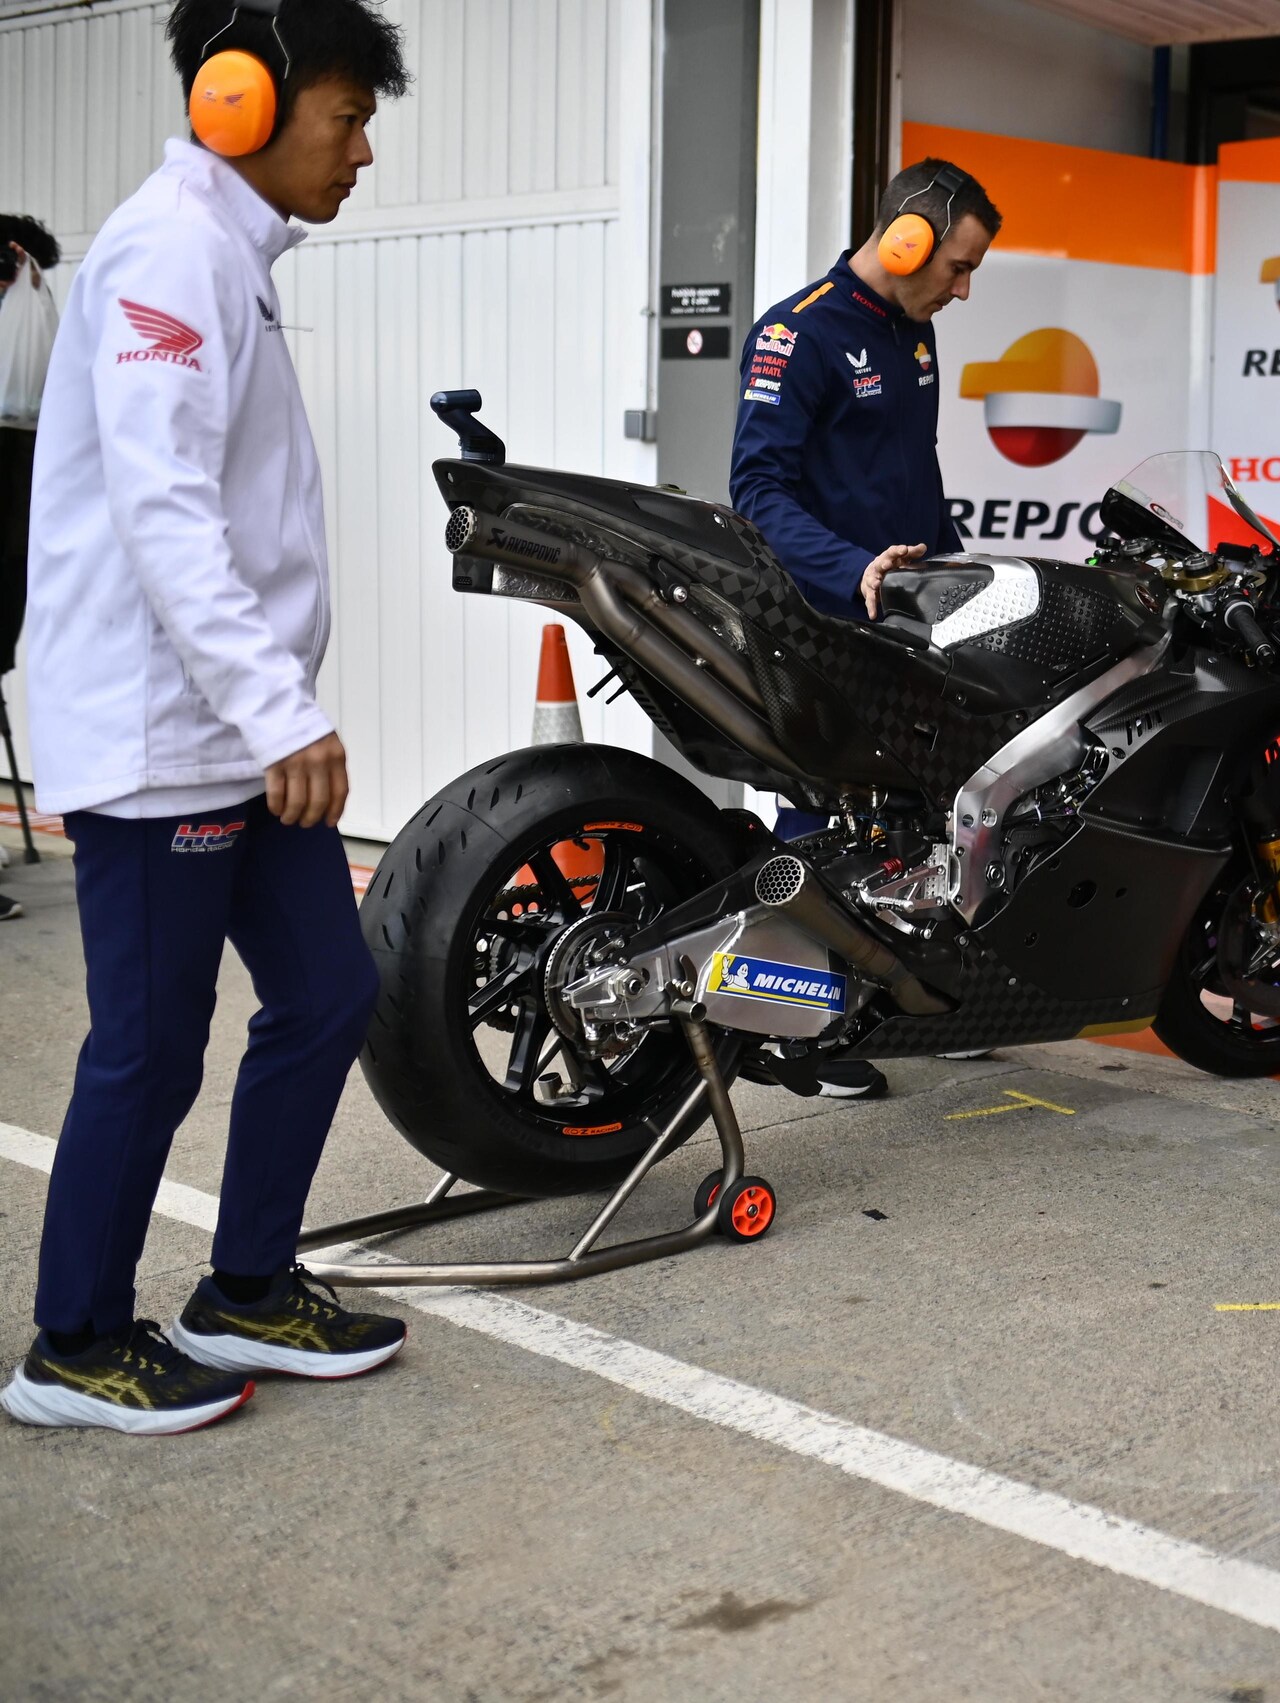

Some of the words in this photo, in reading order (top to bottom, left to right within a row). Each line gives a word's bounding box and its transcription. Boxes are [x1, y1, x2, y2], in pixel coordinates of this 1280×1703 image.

[851, 291, 886, 317] HONDA
[116, 350, 203, 373] HONDA
[853, 375, 882, 395] HRC
[944, 499, 1113, 542] REPSO
[171, 821, 245, 848] HRC
[753, 973, 841, 1001] MICHELIN
